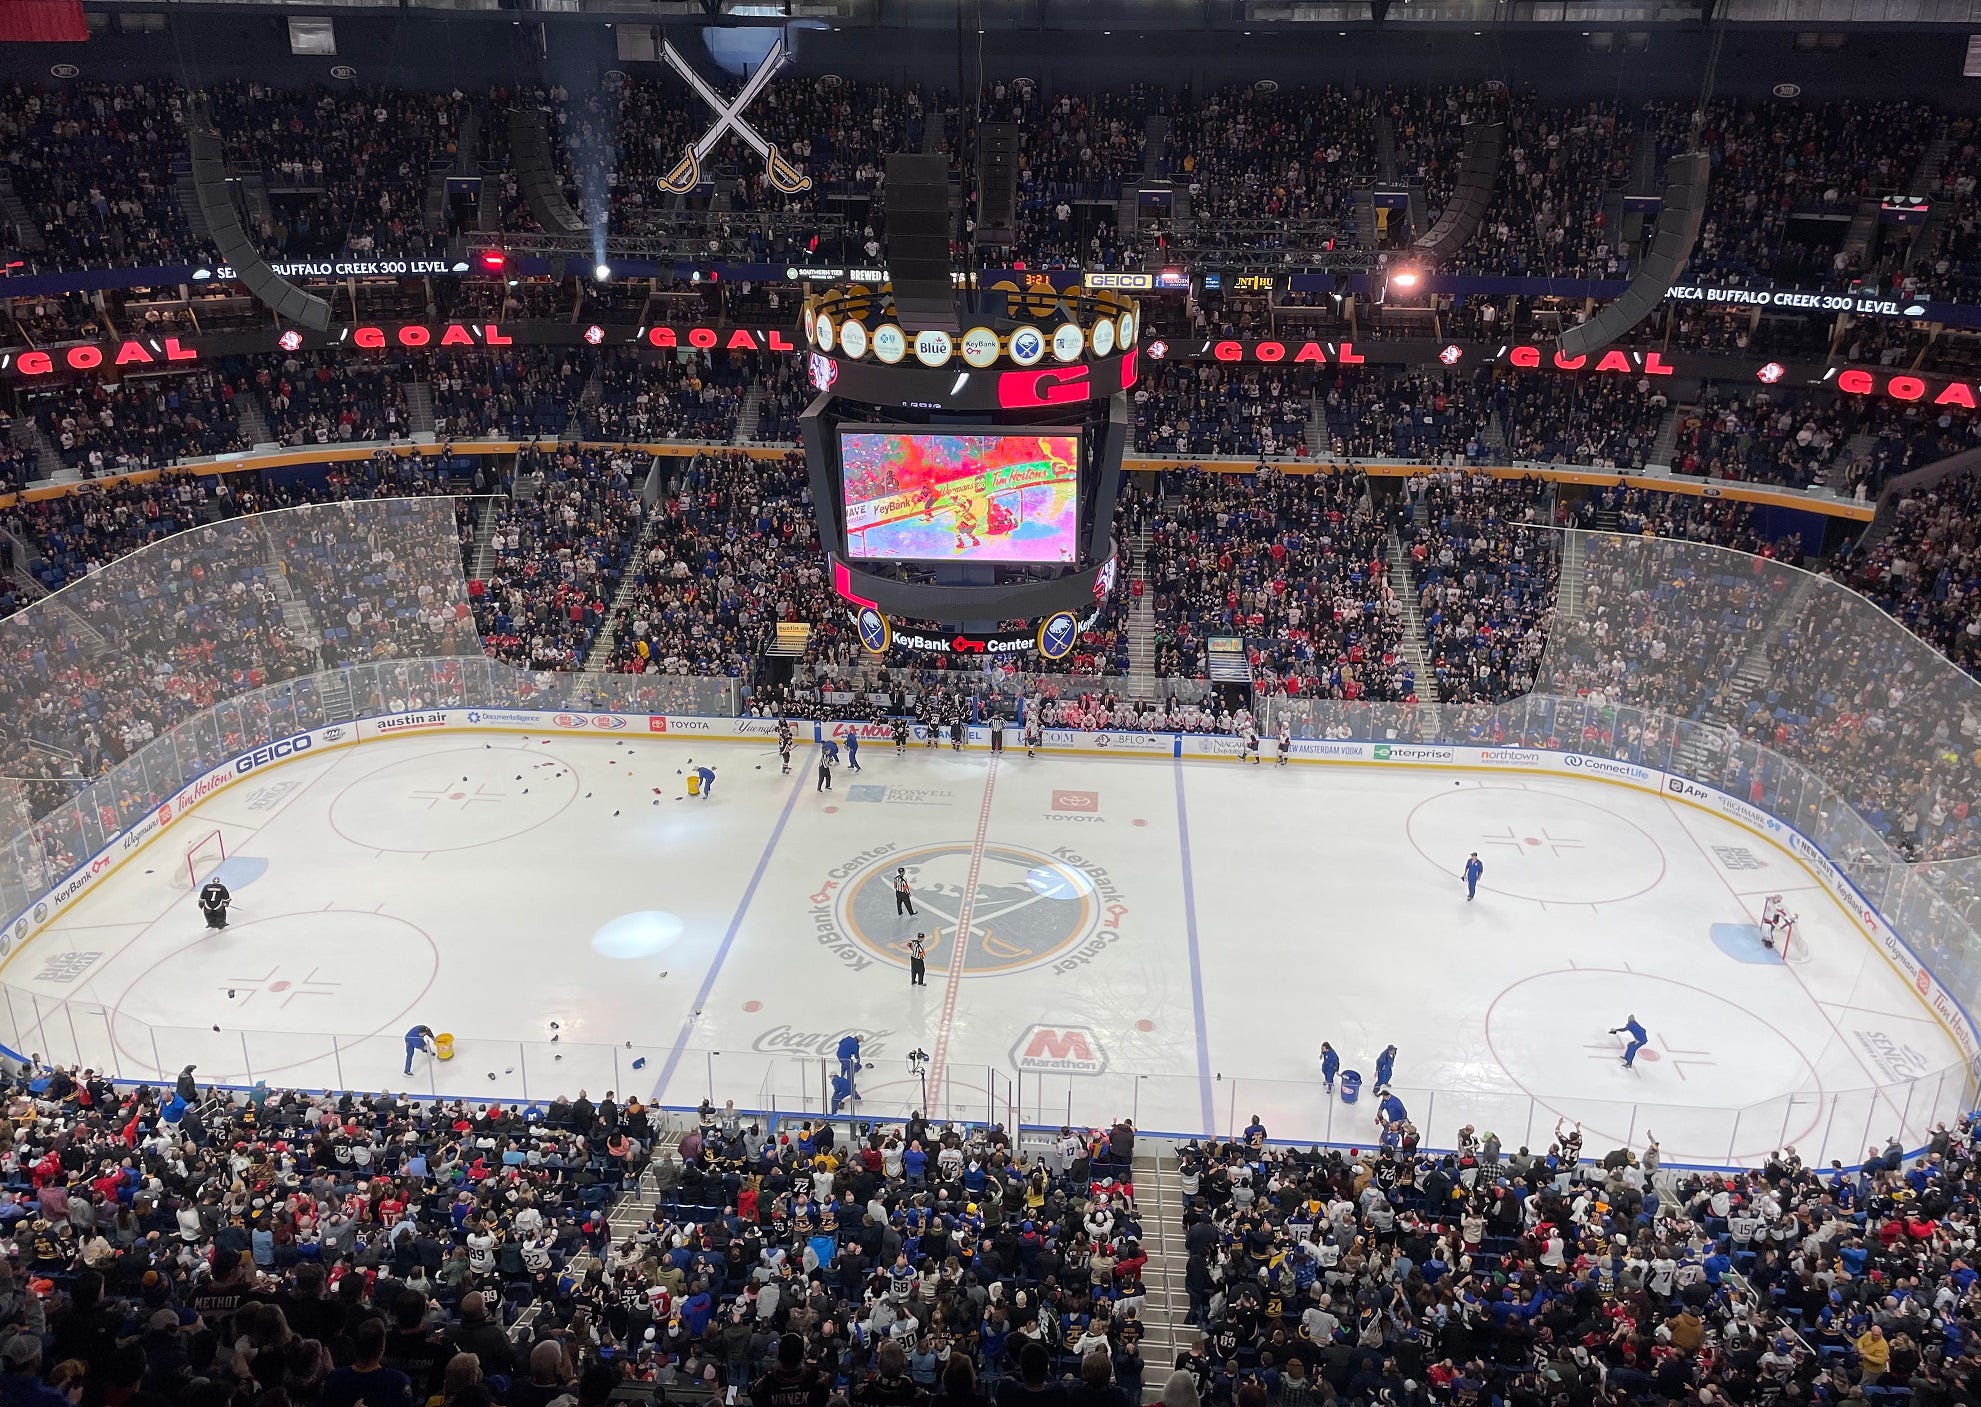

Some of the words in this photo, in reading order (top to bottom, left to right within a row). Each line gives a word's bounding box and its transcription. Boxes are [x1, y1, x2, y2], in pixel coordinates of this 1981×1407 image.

[57, 66, 72, 75] 302
[1780, 87, 1794, 95] 309
[336, 262, 378, 275] CREEK
[380, 261, 407, 274] 300
[411, 260, 449, 273] LEVEL
[850, 270, 882, 281] BREWED
[882, 270, 890, 281] &
[1026, 274, 1049, 285] 3:21
[1091, 275, 1147, 287] GEICO
[1707, 288, 1770, 305] BUFFALO
[1774, 293, 1820, 311] CREEK
[1822, 295, 1851, 311] 300
[1856, 298, 1899, 315] LEVEL
[354, 325, 512, 348] GOAL
[649, 327, 793, 350] GOAL
[920, 342, 947, 354] Blue
[966, 341, 996, 349] KeyBank
[17, 338, 197, 375] GOAL
[1214, 341, 1365, 364] GOAL
[874, 498, 911, 516] KeyBank
[992, 471, 1010, 488] Tim
[1009, 466, 1048, 484] Hortons
[892, 631, 951, 651] KeyBank
[987, 636, 1035, 652] Center
[377, 714, 426, 729] austin
[428, 711, 447, 723] air
[482, 713, 541, 723] Documentelligence
[670, 720, 709, 730] TOYOTA
[1119, 734, 1145, 745] BFLO
[235, 735, 312, 774] GEICO
[1299, 744, 1340, 755] AMSTERDAM
[1341, 746, 1363, 755] VODKA
[1377, 746, 1451, 760] enterprise
[1481, 750, 1539, 761] northtown
[1585, 758, 1649, 780] ConnectLife
[176, 793, 194, 813] Tim
[194, 770, 233, 799] Hortons
[887, 794, 925, 802] PARK
[888, 788, 956, 798] ROSWELL
[1684, 785, 1708, 799] App
[1043, 814, 1105, 823] TOYOTA
[1723, 799, 1766, 825] HIGHMARK
[124, 818, 159, 850] Wegmans
[1801, 841, 1817, 859] NEW
[828, 842, 897, 880] Center
[1051, 846, 1125, 903] KeyBank
[54, 871, 92, 906] KeyBank
[211, 892, 217, 902] 1
[1836, 881, 1864, 919] KeyBank
[808, 904, 874, 972] KeyBank
[1052, 930, 1120, 976] Center
[1885, 936, 1917, 977] Wegmans
[1933, 988, 1951, 1021] Tim
[1021, 1058, 1096, 1070] Marathon
[1066, 1147, 1075, 1157] 17
[1379, 1168, 1395, 1180] 72
[793, 1182, 809, 1193] 72
[1294, 1230, 1308, 1242] 16
[1739, 1224, 1751, 1235] 15
[469, 1247, 485, 1260] 89
[525, 1254, 542, 1266] 22
[1662, 1271, 1671, 1283] 7
[893, 1282, 908, 1293] 68
[195, 1296, 240, 1309] METHOT
[1268, 1302, 1282, 1313] 24
[1220, 1335, 1237, 1348] 89
